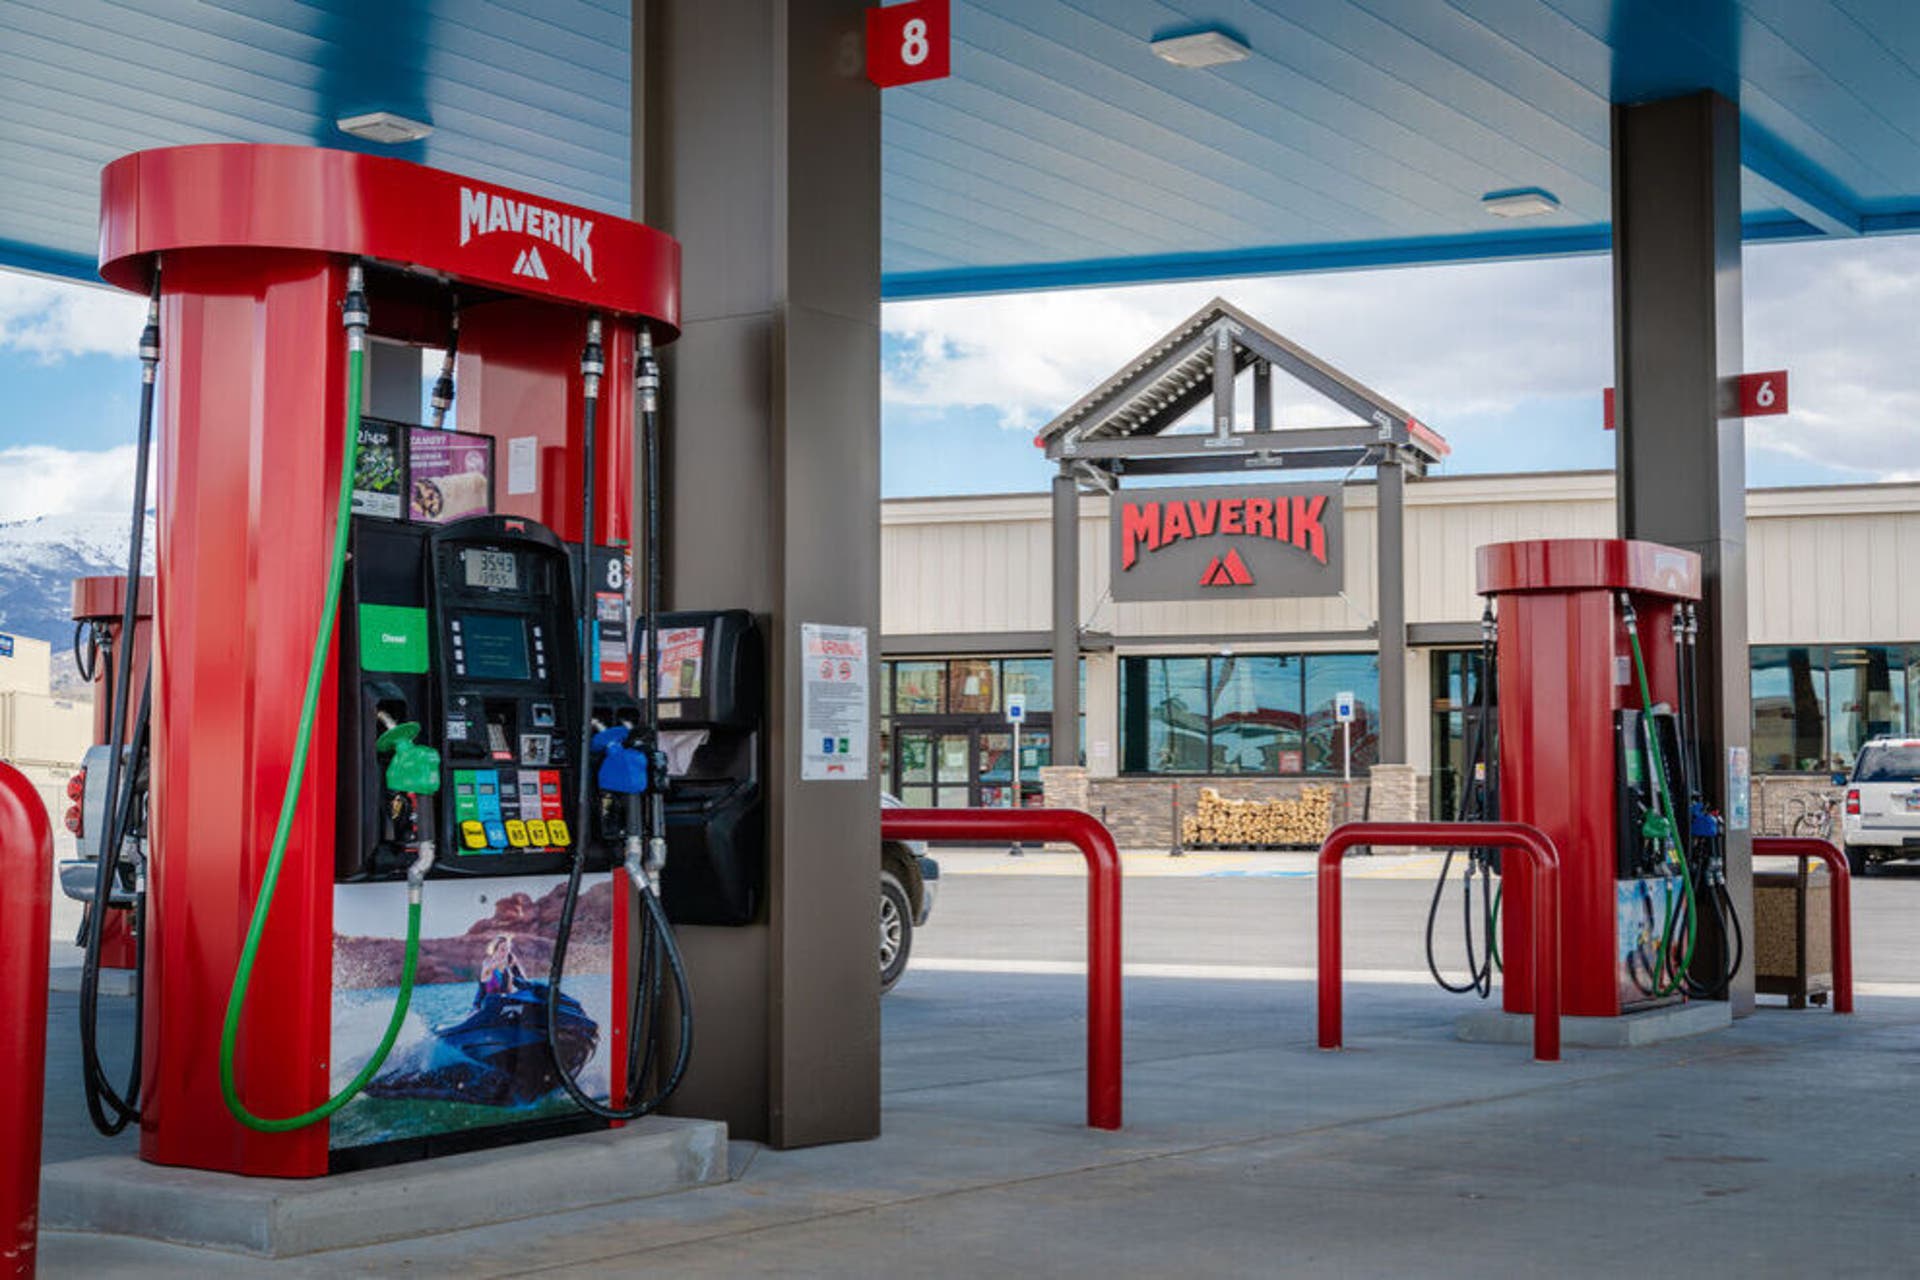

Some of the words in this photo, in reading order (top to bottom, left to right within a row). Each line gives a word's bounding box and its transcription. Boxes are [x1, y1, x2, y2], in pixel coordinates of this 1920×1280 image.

[901, 18, 928, 66] 8
[460, 186, 595, 282] MAVERIK
[1756, 380, 1775, 407] 6
[1122, 495, 1328, 571] MAVERIK
[607, 558, 622, 589] 8
